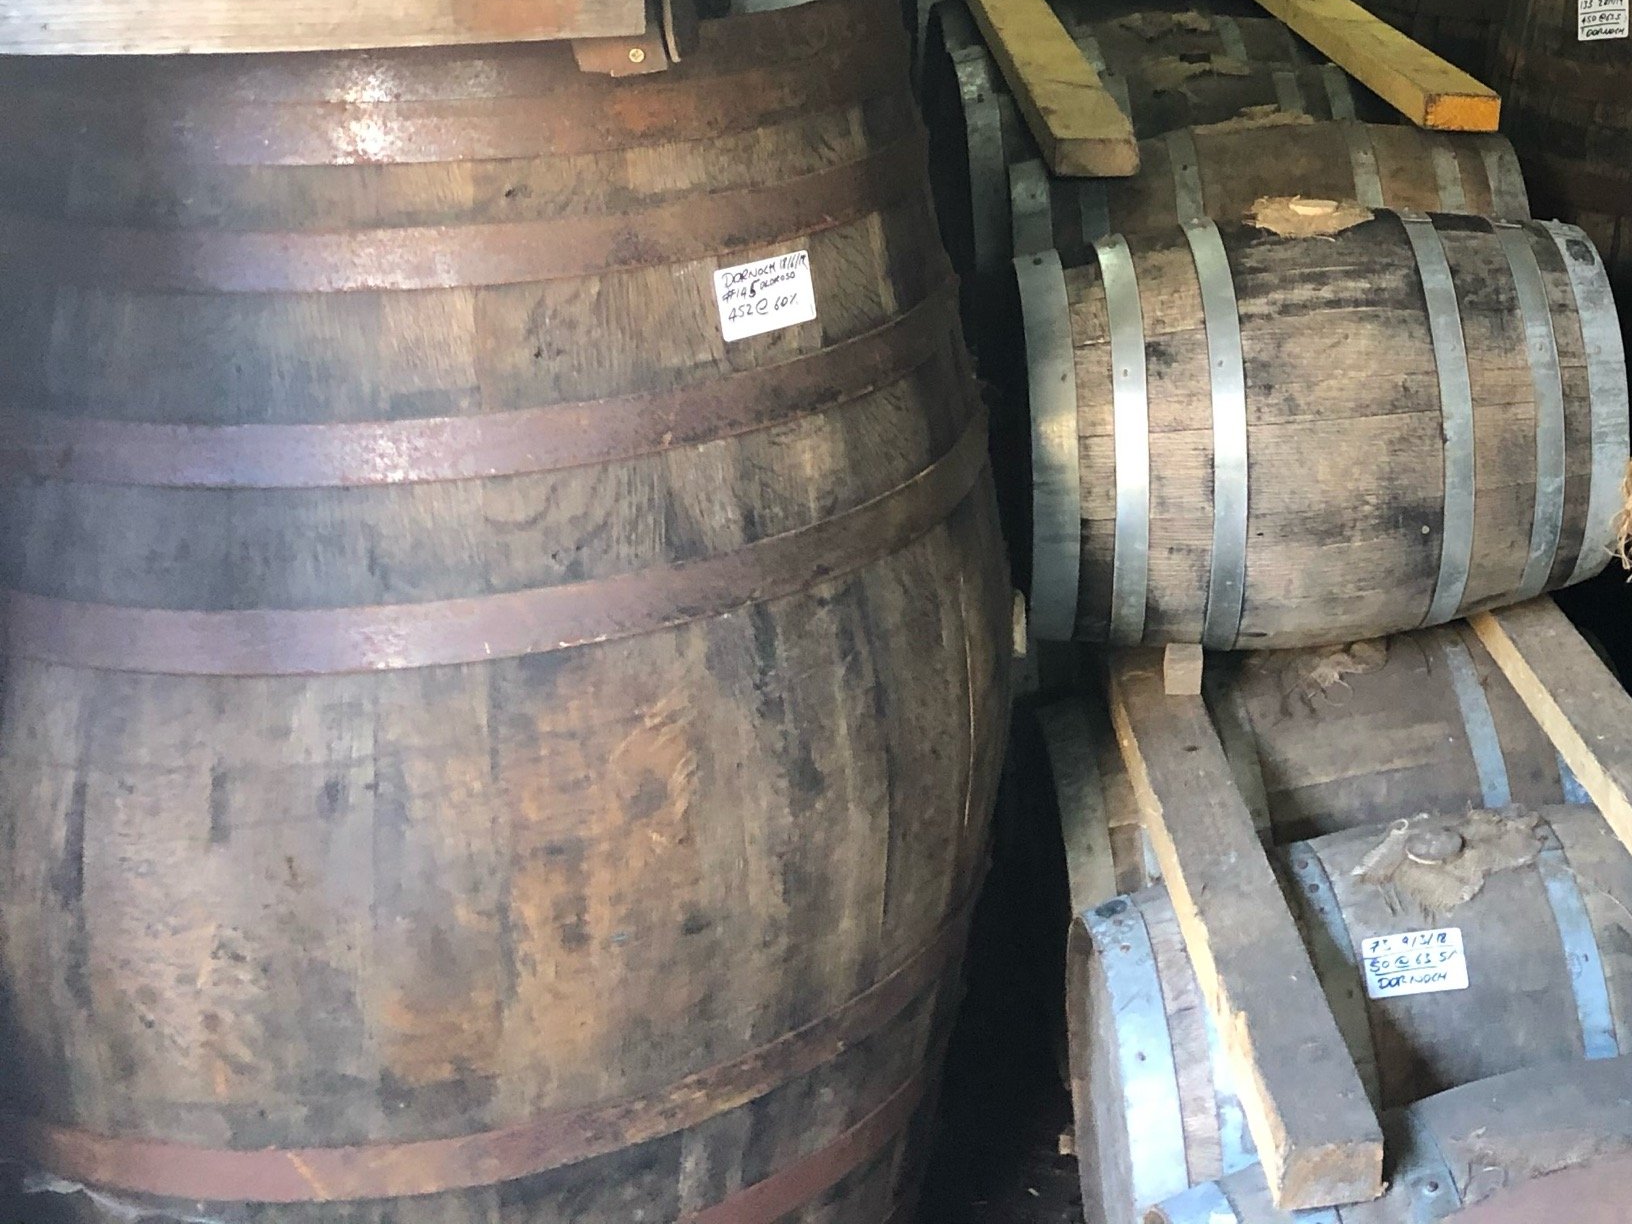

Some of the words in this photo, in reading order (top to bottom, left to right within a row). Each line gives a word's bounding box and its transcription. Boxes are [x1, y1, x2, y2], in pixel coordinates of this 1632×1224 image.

[721, 262, 776, 289] DORNOCH
[728, 303, 754, 323] 452
[1377, 972, 1448, 990] DORNOCH
